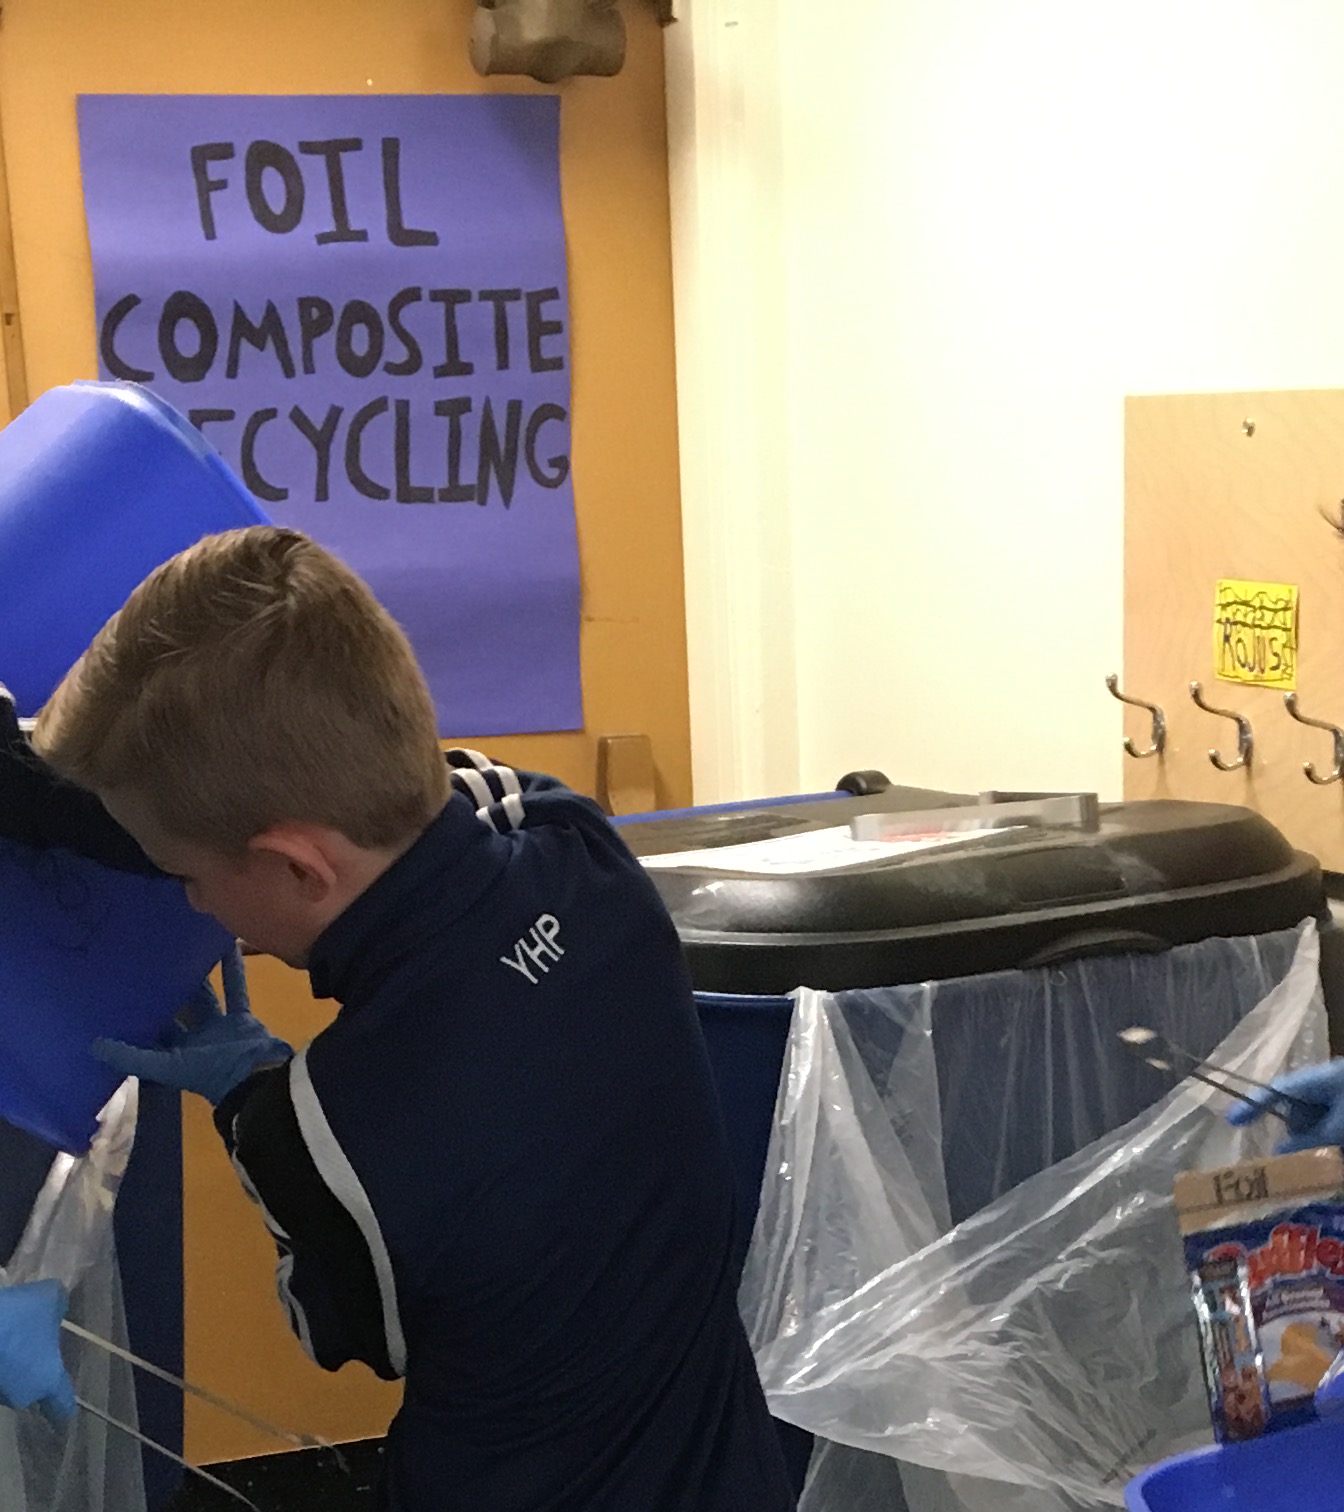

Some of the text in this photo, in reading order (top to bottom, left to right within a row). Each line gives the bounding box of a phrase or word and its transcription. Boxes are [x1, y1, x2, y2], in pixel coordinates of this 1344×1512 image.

[190, 136, 440, 247] FOIL
[99, 286, 565, 382] COMPOSITE
[499, 913, 566, 985] YHP
